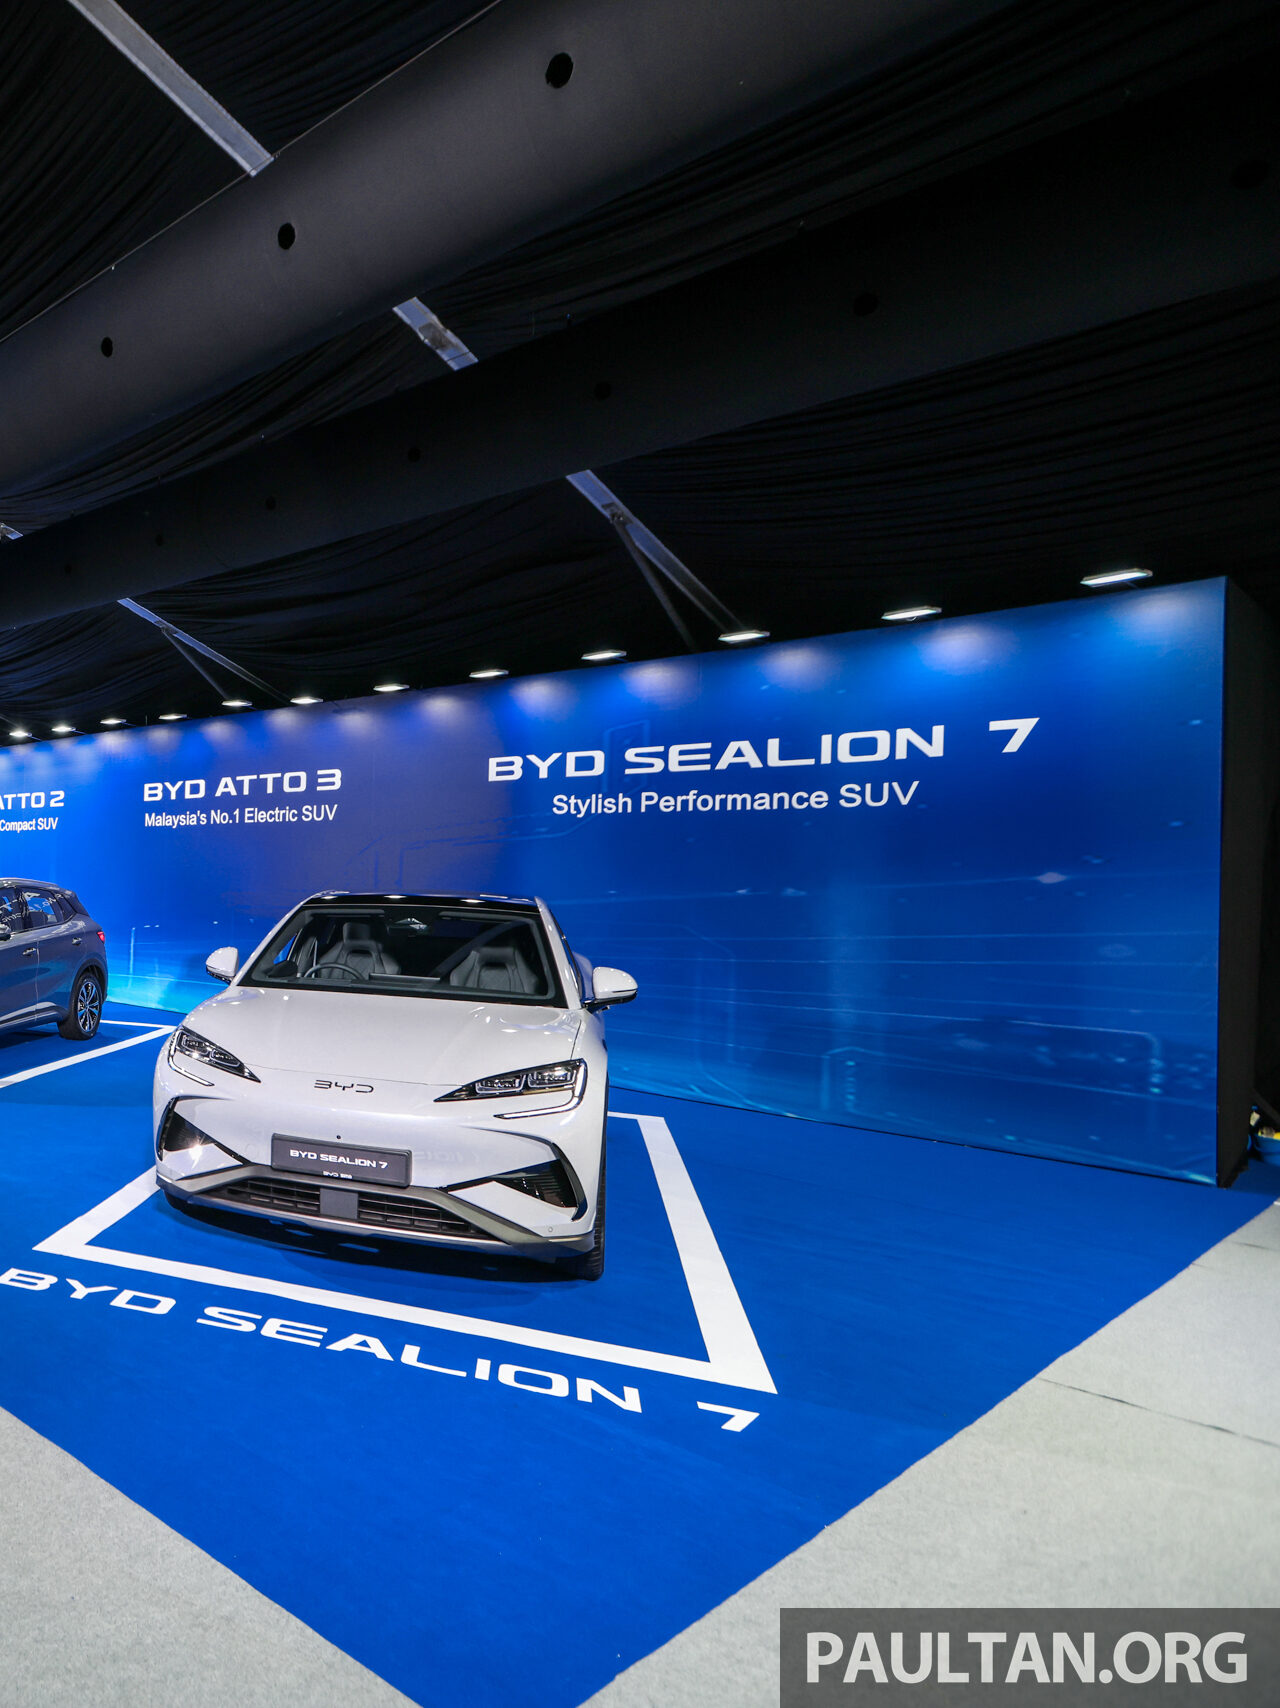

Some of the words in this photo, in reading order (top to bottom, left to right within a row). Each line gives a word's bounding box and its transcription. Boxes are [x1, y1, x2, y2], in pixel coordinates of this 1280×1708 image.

[488, 750, 605, 782] BYD
[624, 725, 945, 774] SEALION
[989, 717, 1041, 753] 7
[143, 779, 206, 802] BYD
[214, 771, 307, 797] ATTO
[316, 769, 342, 791] 3
[49, 790, 65, 807] 2
[552, 792, 632, 818] Stylish
[640, 788, 829, 813] Performance
[838, 780, 920, 808] SUV
[0, 818, 36, 834] Compact
[37, 817, 59, 830] SUV
[144, 811, 207, 829] Malaysia's
[210, 809, 240, 824] No.1
[244, 806, 298, 823] Electric
[301, 804, 338, 821] SUV
[314, 1079, 374, 1094] BYD
[289, 1149, 317, 1160] BYD
[320, 1152, 376, 1168] SEALION
[378, 1161, 388, 1169] 7
[195, 1306, 643, 1414] SEALION
[696, 1401, 761, 1433] 7
